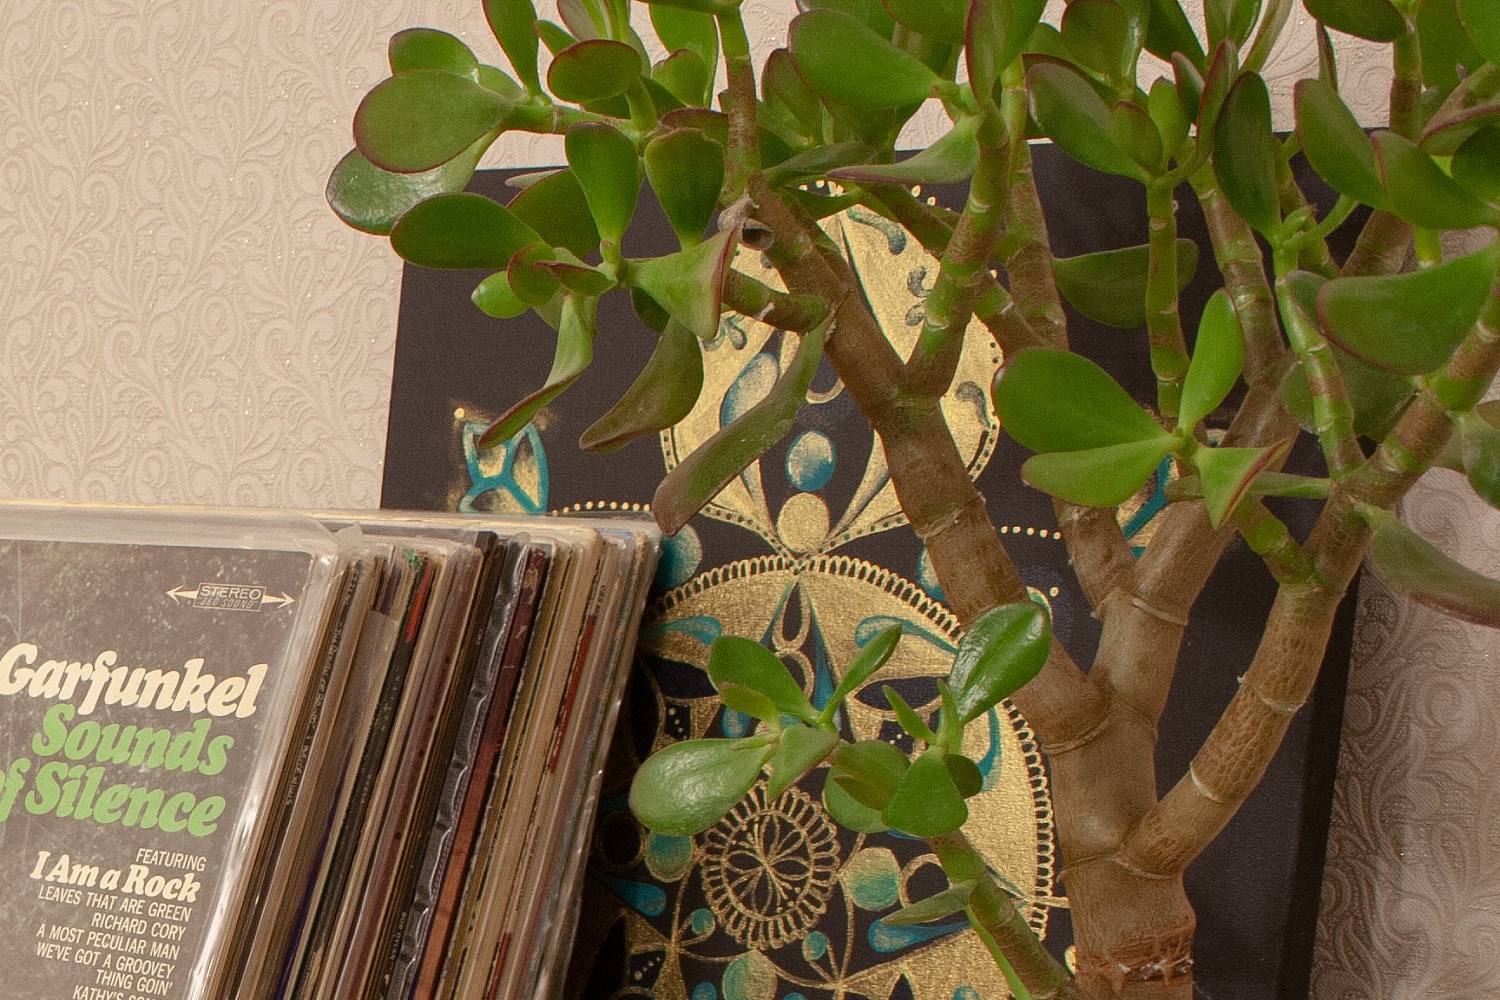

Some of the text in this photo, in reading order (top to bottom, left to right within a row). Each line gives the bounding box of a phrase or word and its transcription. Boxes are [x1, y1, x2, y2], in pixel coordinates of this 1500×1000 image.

[200, 585, 261, 600] STEREO
[32, 703, 234, 776] Sounds
[25, 762, 226, 837] Silence
[30, 850, 201, 902] I Am a Rock
[135, 847, 207, 872] FEATURING
[38, 885, 192, 922] LEAVES THAT ARE GREEN
[36, 923, 180, 960] A MOST PECULIAR MAN
[91, 913, 187, 942] RICHARD CORY
[35, 942, 175, 980] WE'VE GOT A GROOVEY
[95, 969, 173, 996] THING GOIN'
